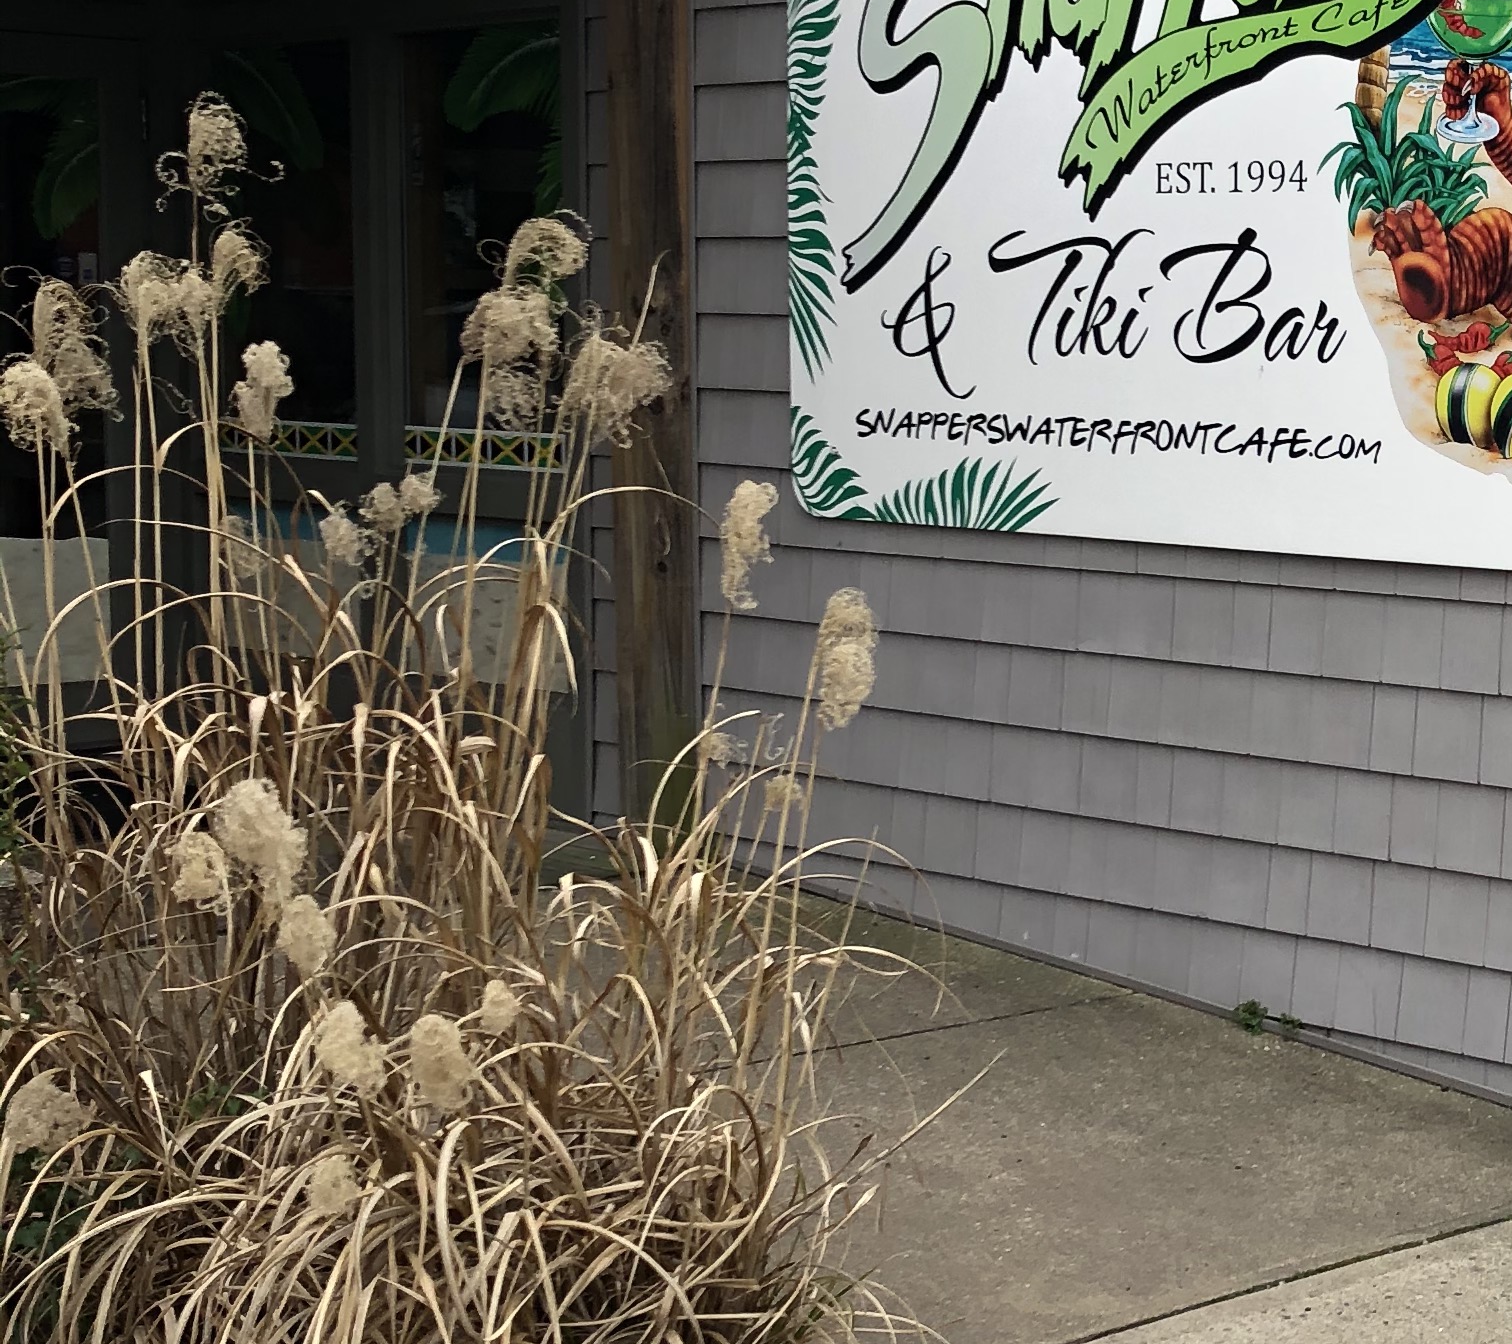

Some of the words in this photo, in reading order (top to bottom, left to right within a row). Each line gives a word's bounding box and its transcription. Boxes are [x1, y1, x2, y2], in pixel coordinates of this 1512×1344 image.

[1085, 17, 1299, 149] Waterfront
[1154, 162, 1217, 195] EST.
[1228, 160, 1308, 193] 1994
[881, 246, 976, 400] &
[987, 229, 1156, 365] Tiki
[1158, 228, 1347, 365] Bar
[855, 408, 1383, 464] SNAPPERSWATERFRONTCAFE.COM
